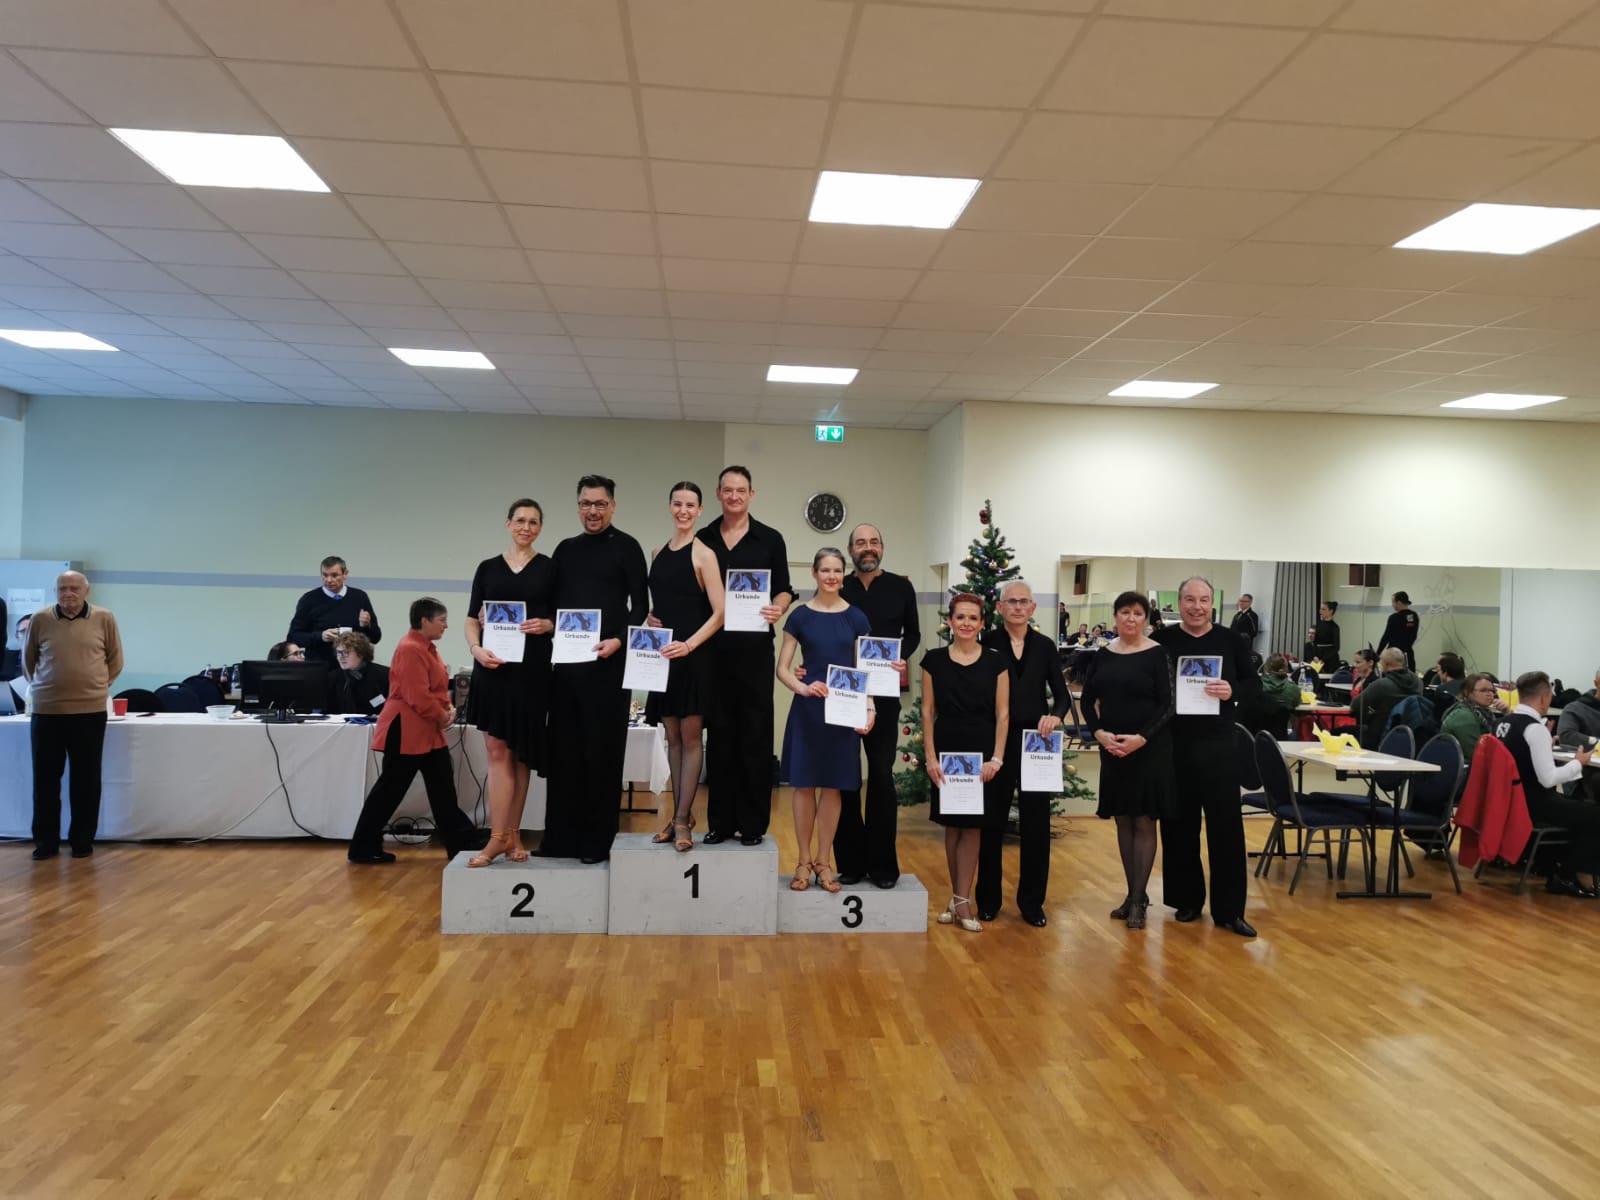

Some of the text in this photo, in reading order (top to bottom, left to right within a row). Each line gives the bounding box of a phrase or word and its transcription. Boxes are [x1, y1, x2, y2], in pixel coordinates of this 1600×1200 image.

[835, 690, 858, 699] Urkunde
[684, 863, 699, 899] 1
[510, 882, 535, 918] 2
[841, 895, 863, 929] 3
